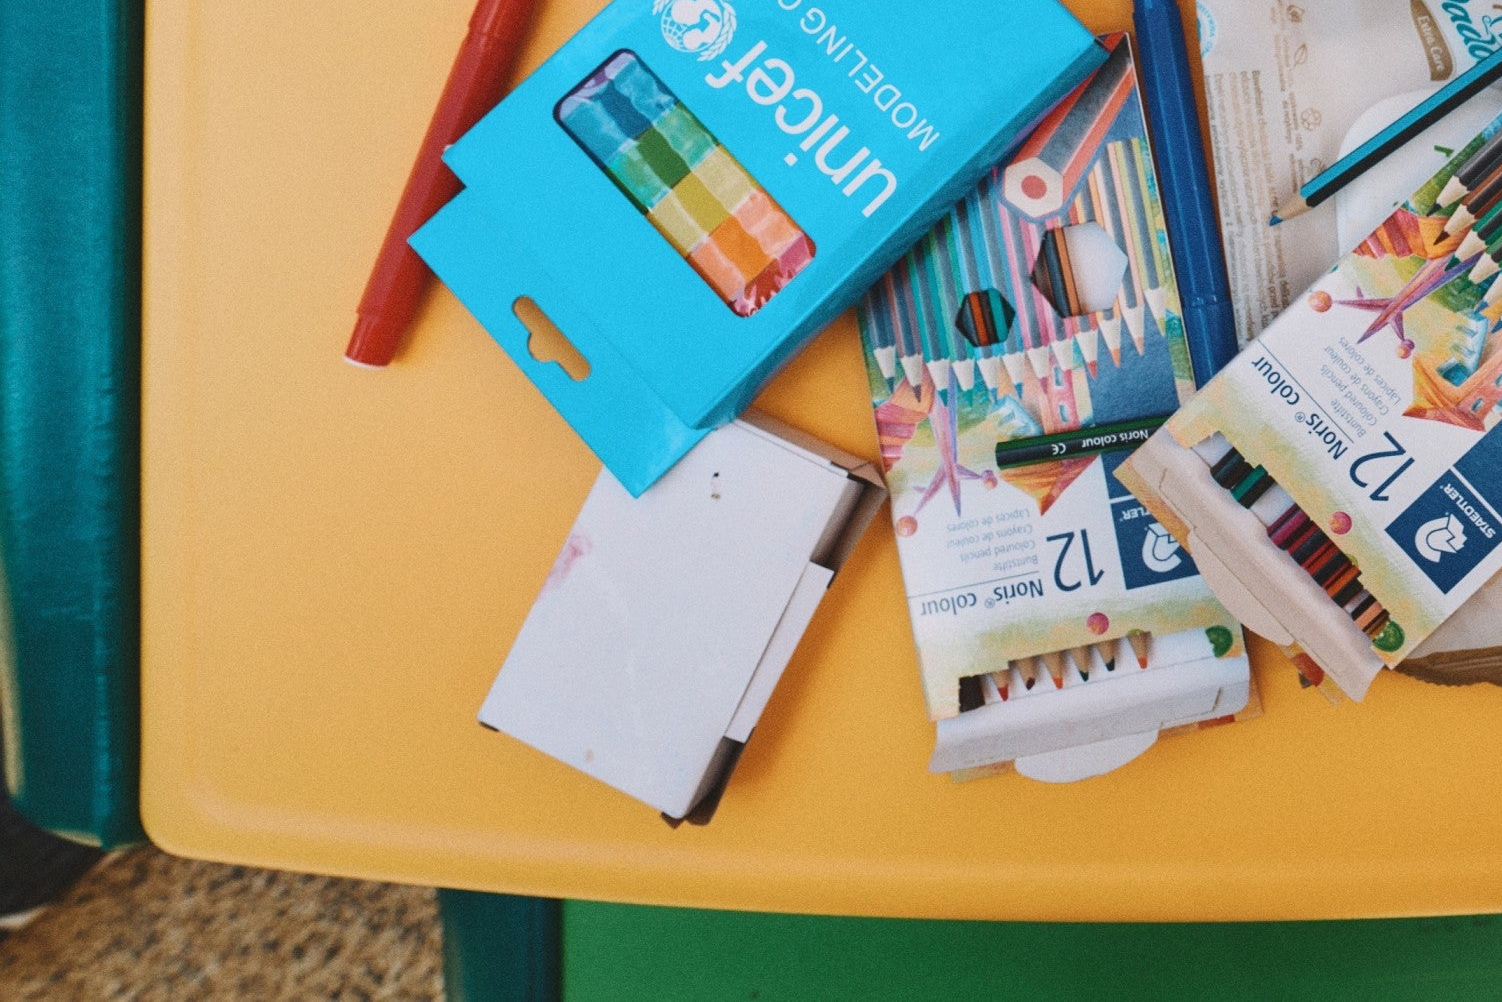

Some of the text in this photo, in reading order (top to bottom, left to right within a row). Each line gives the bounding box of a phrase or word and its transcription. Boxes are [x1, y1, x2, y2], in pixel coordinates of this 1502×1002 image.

[1419, 15, 1445, 72] Extra Care
[799, 6, 940, 152] MODELING
[704, 40, 897, 218] unicef
[1338, 336, 1365, 366] colores
[1363, 364, 1375, 376] de
[1251, 356, 1300, 406] colour
[1321, 364, 1377, 426] Coloured pencils
[1324, 345, 1389, 416] Crayons de couleur
[1082, 434, 1117, 448] colour
[1119, 429, 1149, 444] Noris
[1349, 430, 1416, 502] 12
[1442, 483, 1497, 539] STAEDTLER
[1046, 528, 1105, 592] 12
[920, 592, 977, 617] colour
